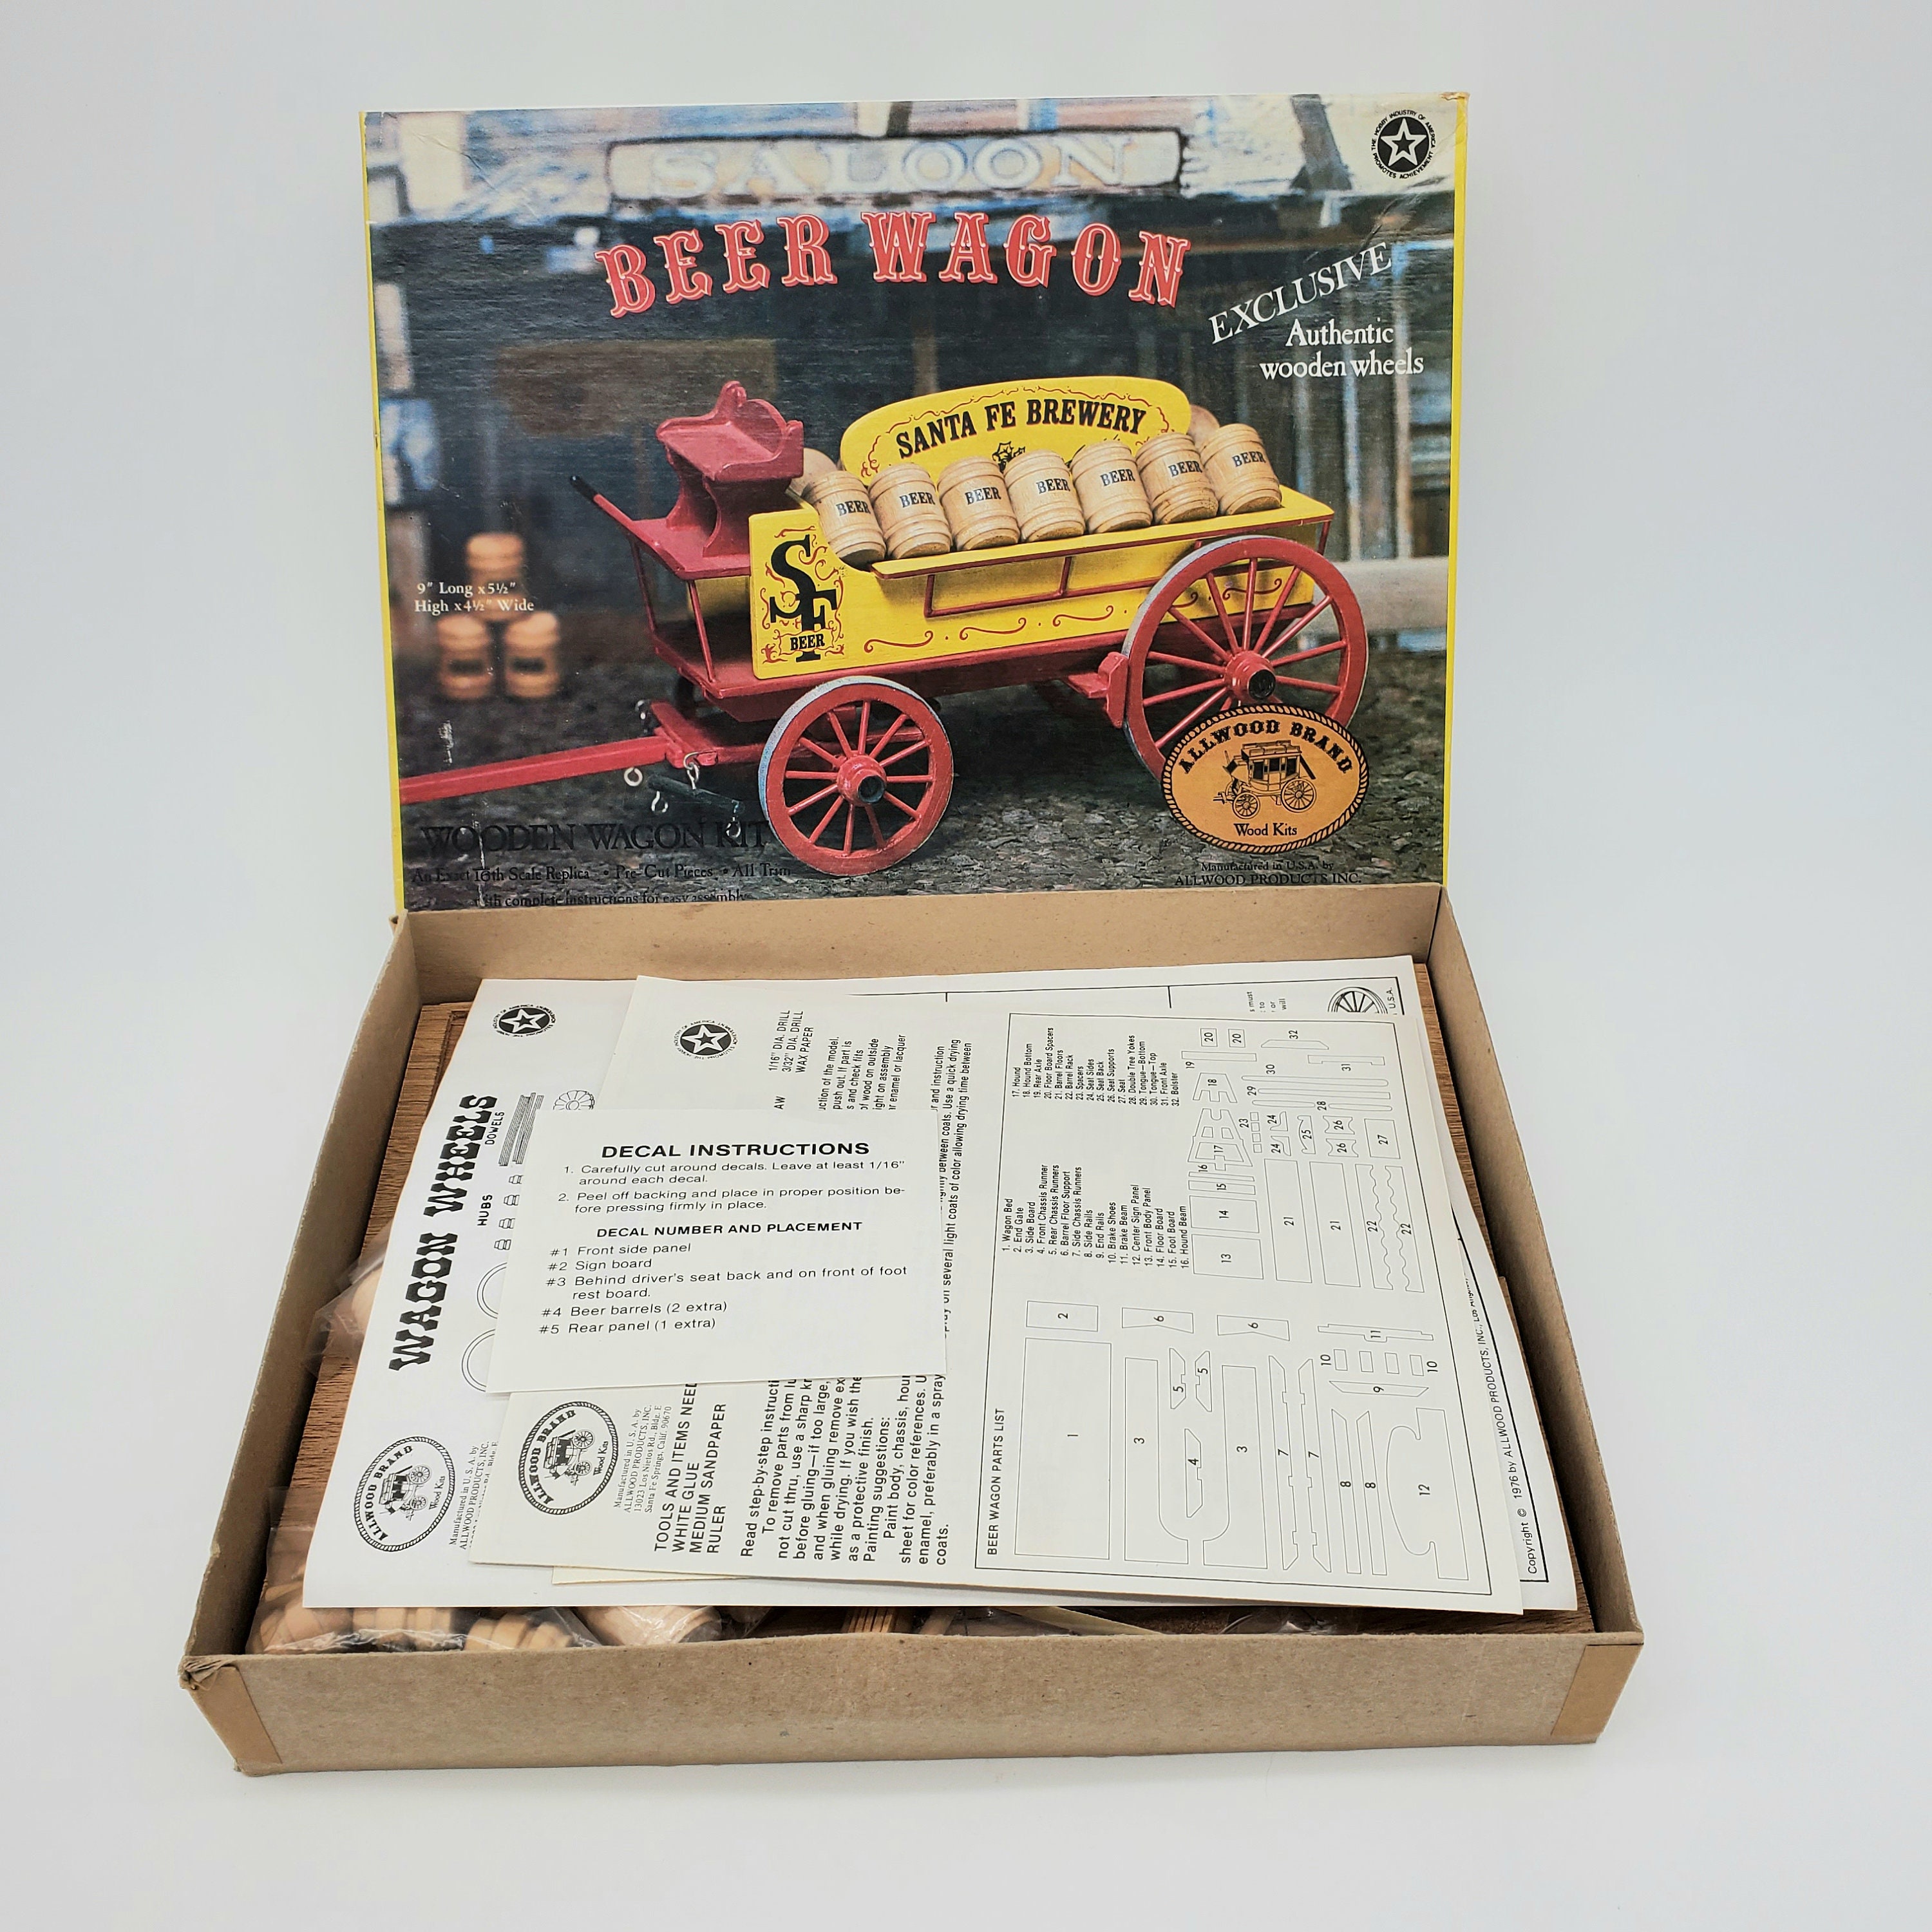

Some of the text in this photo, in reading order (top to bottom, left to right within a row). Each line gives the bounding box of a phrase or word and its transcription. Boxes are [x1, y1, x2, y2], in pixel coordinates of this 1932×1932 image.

[1389, 109, 1417, 118] INDUSTRY
[649, 135, 1133, 197] SALOON
[1373, 151, 1433, 178] PROMOTES ACHIEVEMENT
[594, 211, 1191, 318] BEER WAGON
[1208, 242, 1391, 345] EXCLUSIVE
[1285, 317, 1394, 346] Authentic
[1260, 347, 1424, 380] wooden wheels
[896, 399, 1146, 459] SANTA FE BREWERY
[1231, 451, 1265, 467] BEER
[1168, 460, 1203, 477] BEER
[1036, 478, 1070, 493] BEER
[1100, 469, 1135, 486] BEER
[899, 492, 934, 508] BEER
[965, 487, 1001, 504] BEER
[837, 501, 870, 515] BEER
[439, 582, 473, 598] Long
[414, 600, 448, 616] High
[498, 599, 534, 611] Wide
[790, 634, 825, 650] BEER
[1179, 719, 1353, 774] ALLWOOD BRAND
[421, 820, 773, 853] WOODEN WAGON KIT
[1233, 823, 1298, 837] Wood Kits
[675, 864, 713, 877] Pieces
[732, 863, 791, 877] All Trim
[1202, 862, 1269, 871] Manufactured
[1287, 861, 1319, 870] U.S.A.
[1322, 861, 1334, 870] by
[474, 868, 504, 882] 16th
[509, 867, 541, 881] Scale
[546, 866, 590, 884] Replica
[1175, 873, 1361, 886] ALLWOOD PRODUCTS INC.
[777, 1010, 790, 1031] DRILL
[773, 1034, 785, 1050] DIA.
[795, 1027, 813, 1072] WAX PAPER
[1012, 1067, 1021, 1086] Hound
[1170, 1072, 1179, 1095] Bolster
[485, 1112, 504, 1144] DOWELS
[1378, 1135, 1388, 1144] 27
[602, 1143, 869, 1158] DECAL INSTRUCTIONS
[582, 1165, 641, 1174] Carefully
[670, 1163, 716, 1171] around
[722, 1162, 767, 1171] decals.
[870, 1161, 904, 1170] 1/16"
[580, 1175, 707, 1185] around each decal.
[578, 1192, 607, 1200] Peel
[612, 1191, 629, 1200] off
[634, 1191, 687, 1200] backing
[722, 1189, 757, 1198] place
[828, 1187, 879, 1197] position
[477, 1195, 493, 1226] HUBS
[607, 1203, 664, 1213] pressing
[670, 1202, 706, 1211] firmly
[728, 1200, 766, 1210] place.
[1003, 1198, 1012, 1212] Bed
[388, 1094, 498, 1371] WAGON WHEELS
[597, 1222, 862, 1237] DECAL NUMBER AND PLACEMENT
[1002, 1216, 1013, 1242] Wagon
[550, 1243, 690, 1256] #1 Front side panel
[547, 1258, 652, 1271] #2 Sign board
[546, 1278, 565, 1286] #3
[575, 1274, 625, 1285] Behind
[632, 1273, 683, 1283] driver's
[690, 1273, 720, 1282] seat
[727, 1271, 761, 1280] back
[767, 1269, 792, 1279] and
[822, 1267, 855, 1277] front
[861, 1267, 874, 1276] of
[880, 1266, 906, 1275] foot
[573, 1288, 650, 1300] rest board.
[542, 1302, 726, 1317] #4 Beer barrels (2 extra)
[539, 1318, 715, 1334] #5 Rear panel (1 extra)
[1480, 1348, 1499, 1403] PRODUCTS,
[1493, 1406, 1513, 1457] ALLWOOD
[1508, 1461, 1517, 1472] by
[654, 1421, 690, 1551] TOOLS AND ITEMS
[689, 1404, 726, 1553] MEDIUM SANDPAPER
[987, 1408, 1004, 1555] BEER WAGON PARTS LIST
[365, 1446, 413, 1540] ALLWOOD BRAND
[429, 1475, 446, 1510] Wood Kits
[863, 1417, 890, 1561] Painting suggestions:
[1418, 1484, 1430, 1495] 12
[1509, 1476, 1522, 1499] 1976
[741, 1437, 773, 1557] Read step-by-step
[672, 1463, 699, 1552] WHITE GLUE
[706, 1506, 726, 1553] RULER
[1520, 1522, 1537, 1574] Copyright
